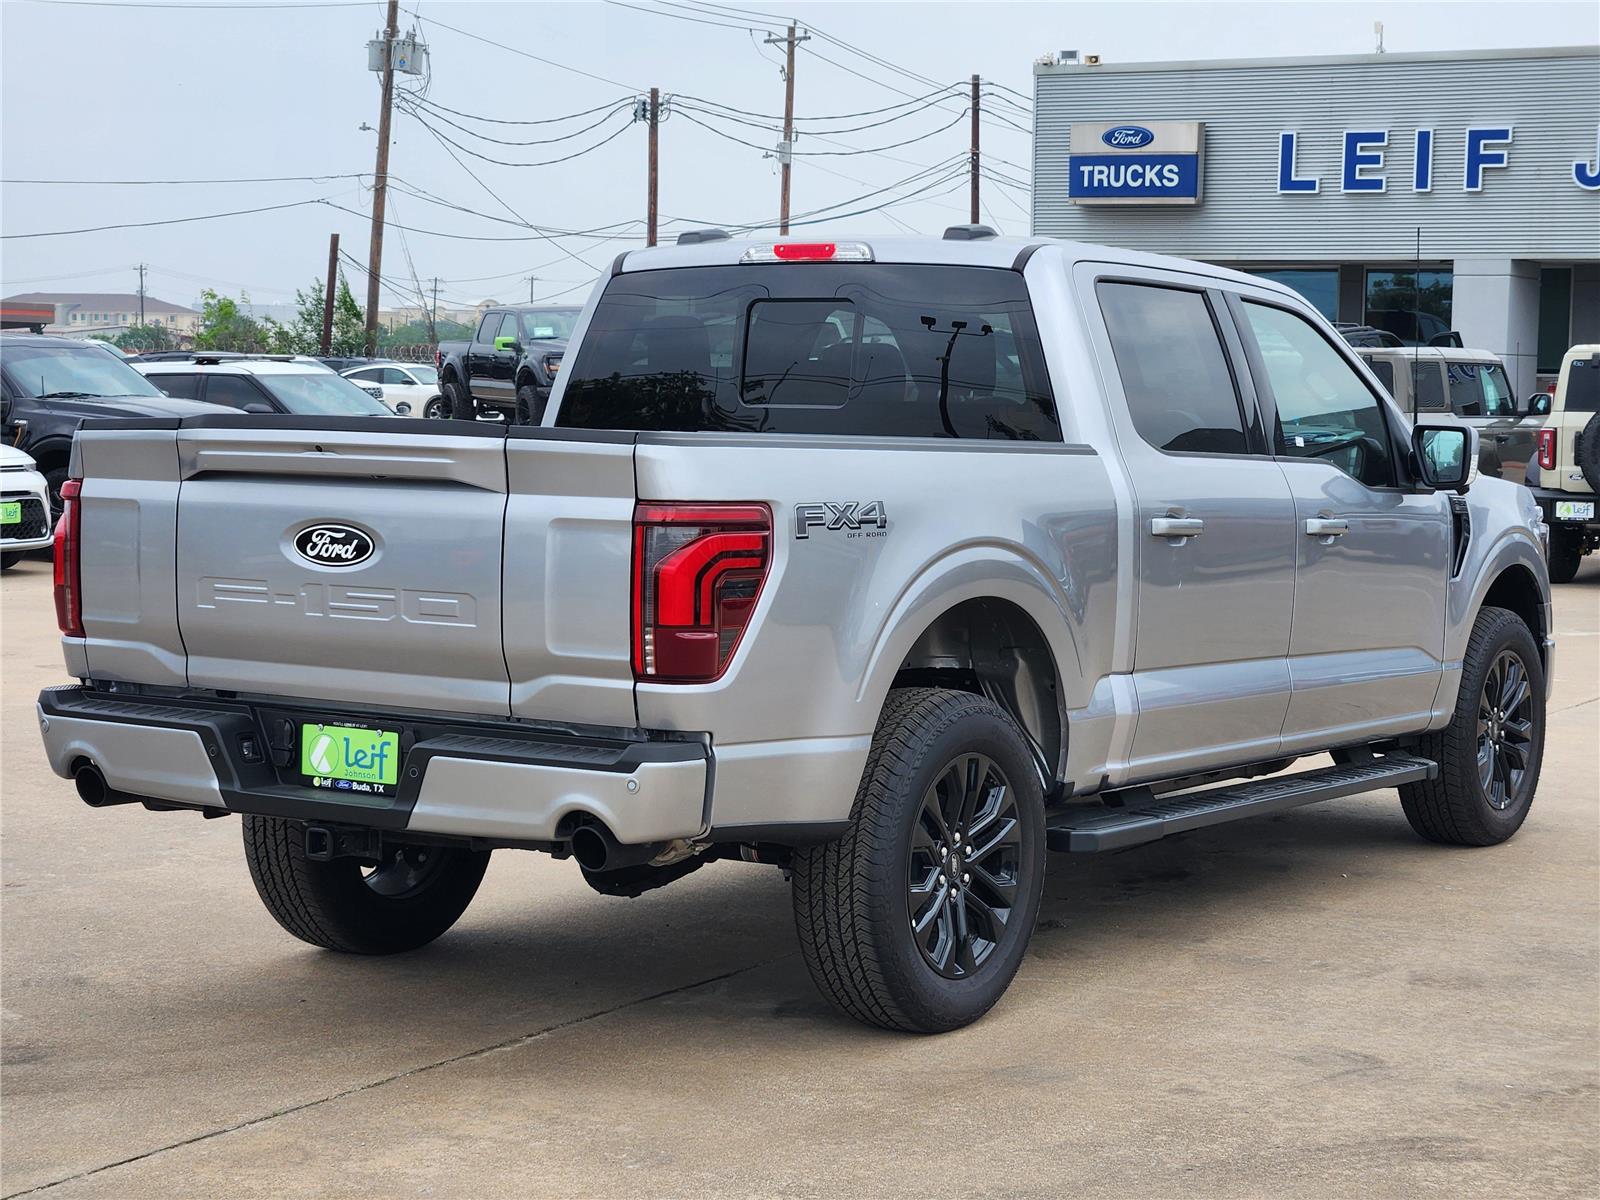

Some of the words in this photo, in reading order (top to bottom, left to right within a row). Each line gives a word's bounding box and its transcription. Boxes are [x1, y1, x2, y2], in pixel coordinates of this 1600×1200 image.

[1111, 129, 1143, 145] Ford
[1080, 164, 1180, 188] TRUCKS
[1277, 126, 1514, 194] LEIF
[794, 501, 888, 540] FX4
[305, 528, 358, 560] Ford
[197, 575, 477, 628] F-150
[343, 736, 391, 780] leif
[344, 769, 376, 780] Johnson
[352, 781, 372, 793] Buda,
[373, 783, 384, 793] TX
